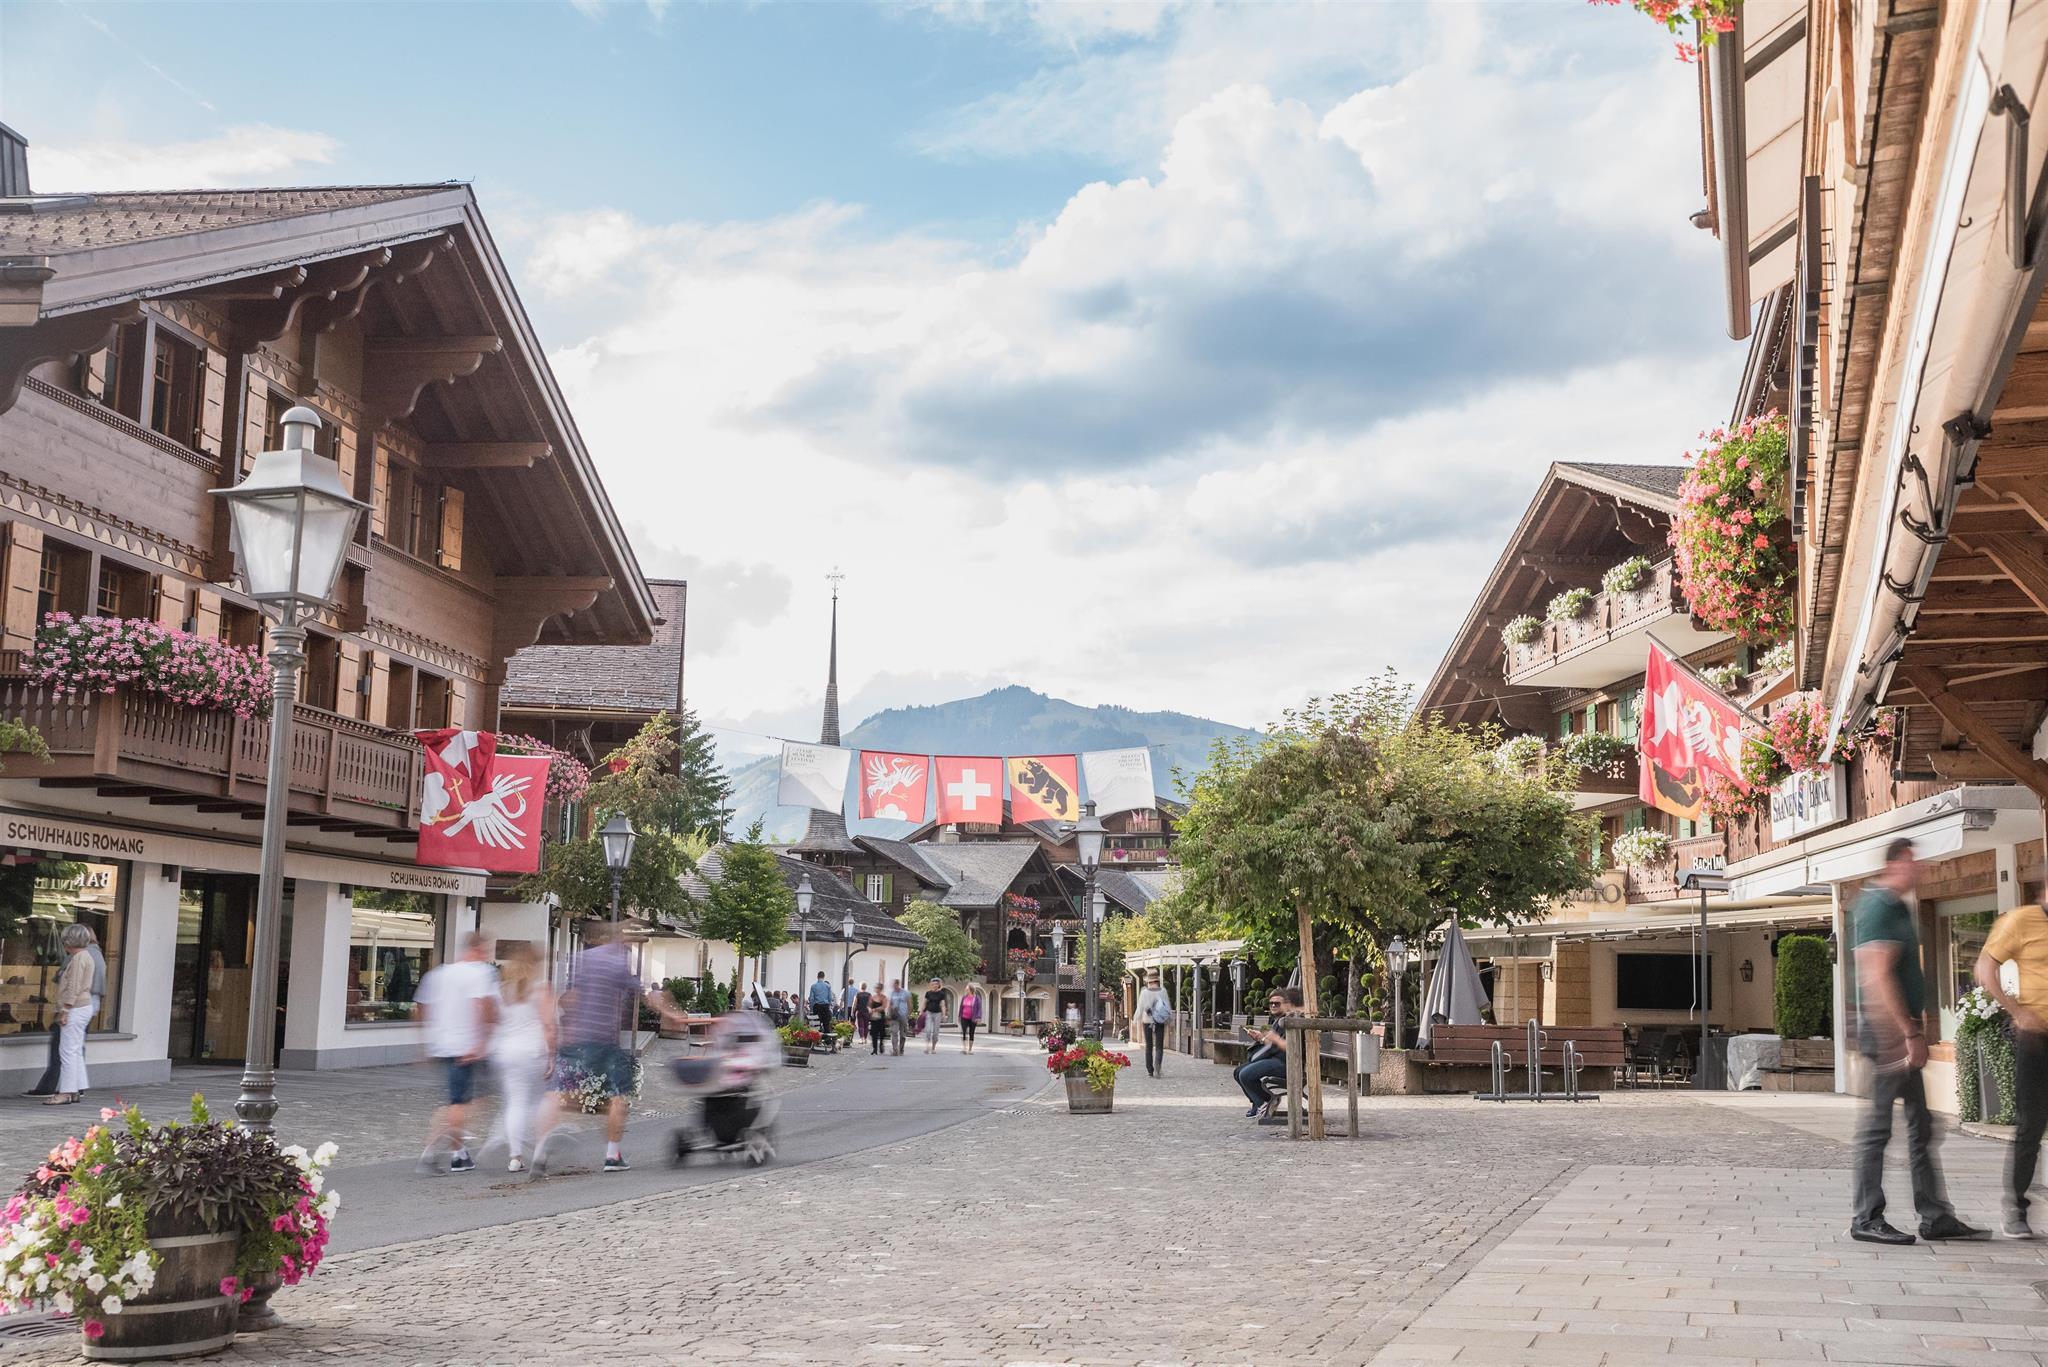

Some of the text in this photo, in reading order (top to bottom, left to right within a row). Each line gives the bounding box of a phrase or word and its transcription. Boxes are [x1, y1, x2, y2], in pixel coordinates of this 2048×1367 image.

[1809, 778, 1831, 808] BANK
[7, 822, 144, 854] SCHUHHAUS ROMANG
[1693, 856, 1712, 870] BACH
[390, 871, 459, 890] SCHUHHAUS ROMANG
